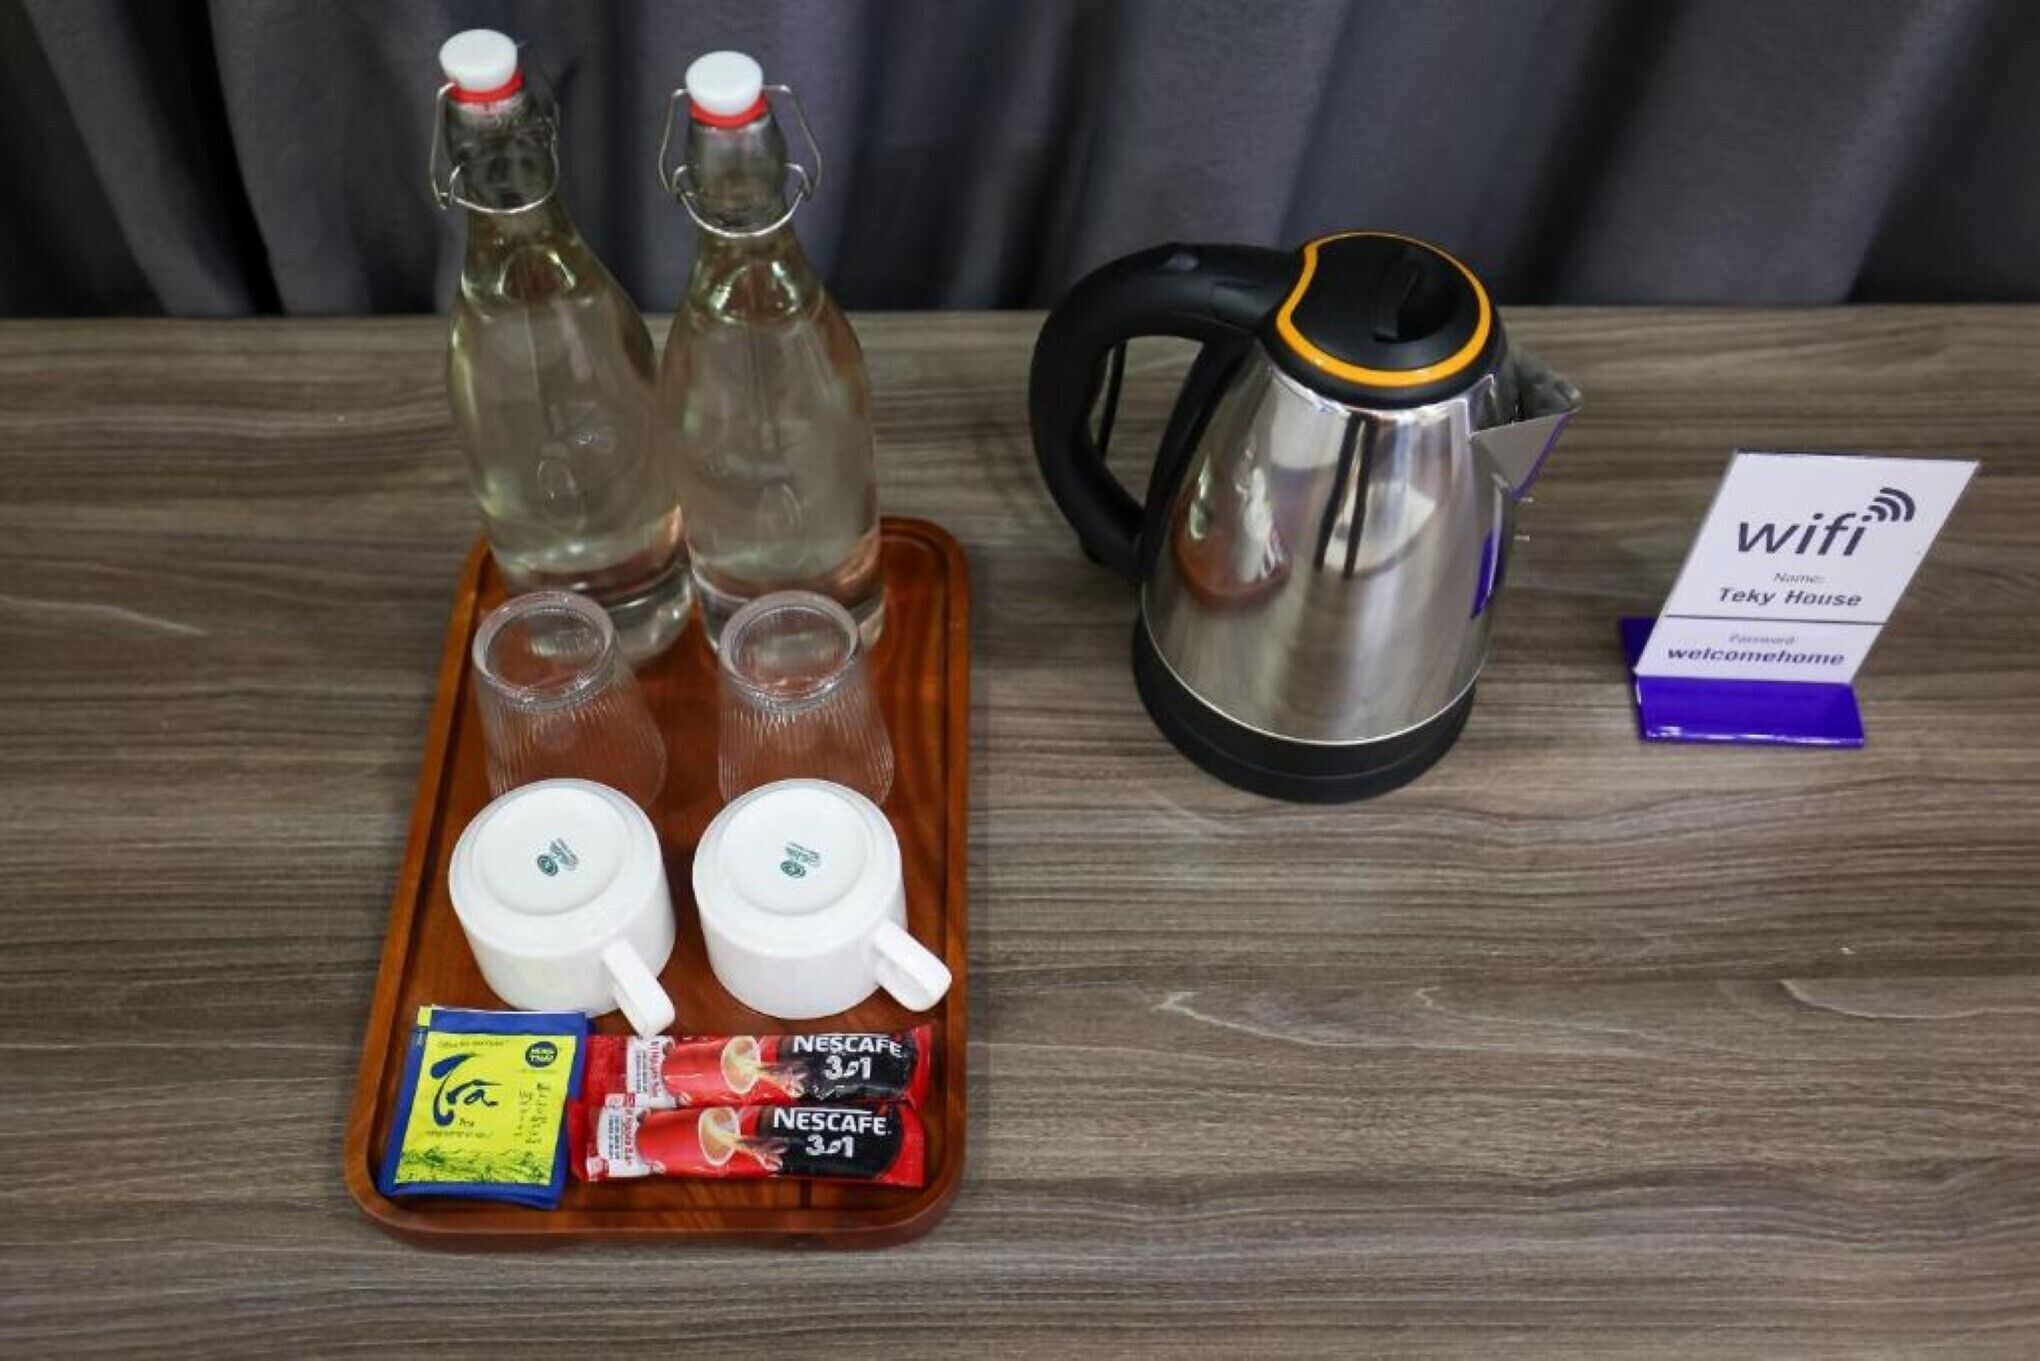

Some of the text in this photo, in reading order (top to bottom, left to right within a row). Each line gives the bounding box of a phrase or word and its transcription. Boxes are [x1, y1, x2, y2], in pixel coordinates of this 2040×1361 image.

[1738, 513, 1874, 557] wifi
[1719, 588, 1863, 608] Teky House
[1668, 647, 1846, 666] welcomehome
